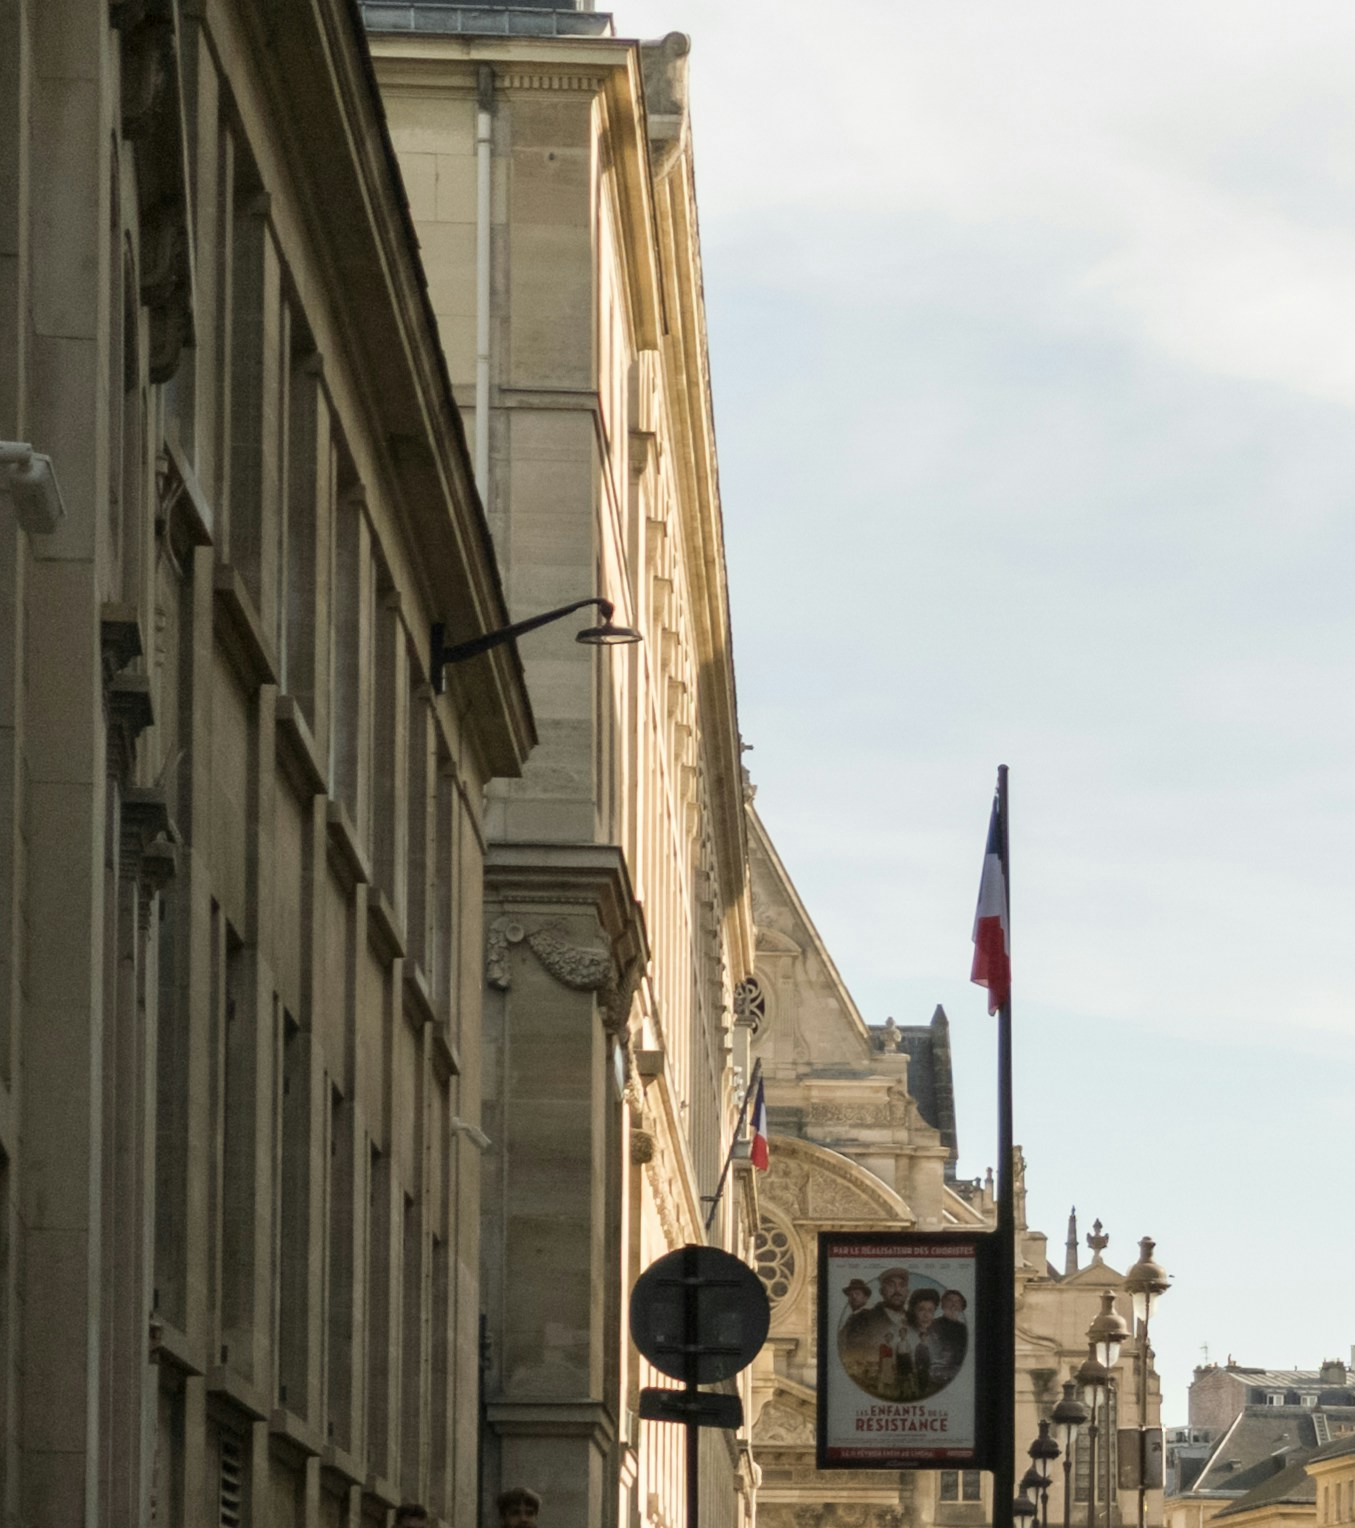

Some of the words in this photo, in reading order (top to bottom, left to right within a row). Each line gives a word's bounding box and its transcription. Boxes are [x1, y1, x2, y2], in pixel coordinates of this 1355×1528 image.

[833, 1246, 849, 1254] PAR
[914, 1246, 929, 1254] DES
[931, 1246, 974, 1254] CHORISTES
[870, 1406, 926, 1416] ENFANTS
[856, 1417, 948, 1432] RÉSISTANCE
